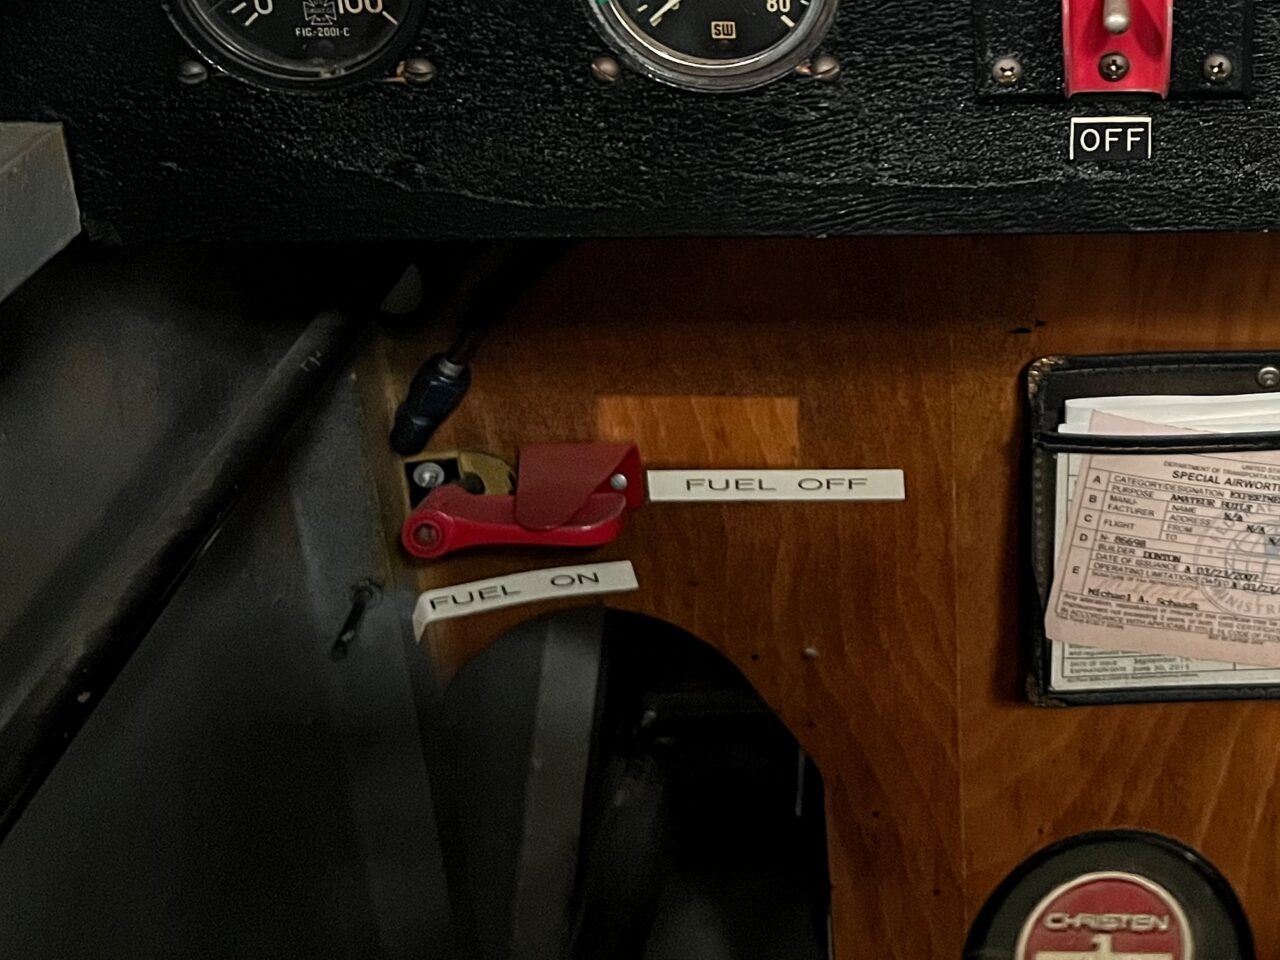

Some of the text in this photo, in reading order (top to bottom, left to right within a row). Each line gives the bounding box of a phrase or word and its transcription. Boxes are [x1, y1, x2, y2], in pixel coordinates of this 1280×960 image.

[714, 23, 734, 38] SW
[1080, 128, 1145, 152] OFF
[686, 478, 869, 492] FUEL OFF
[1093, 475, 1101, 484] A
[1172, 470, 1220, 485] SPECIAL
[1088, 495, 1097, 503] B
[1084, 514, 1093, 522] C
[1103, 519, 1135, 530] FLIGHT
[1079, 533, 1088, 541] D
[1071, 565, 1080, 574] E
[429, 571, 601, 612] FUEL ON
[1044, 912, 1171, 932] CHRISTEN
